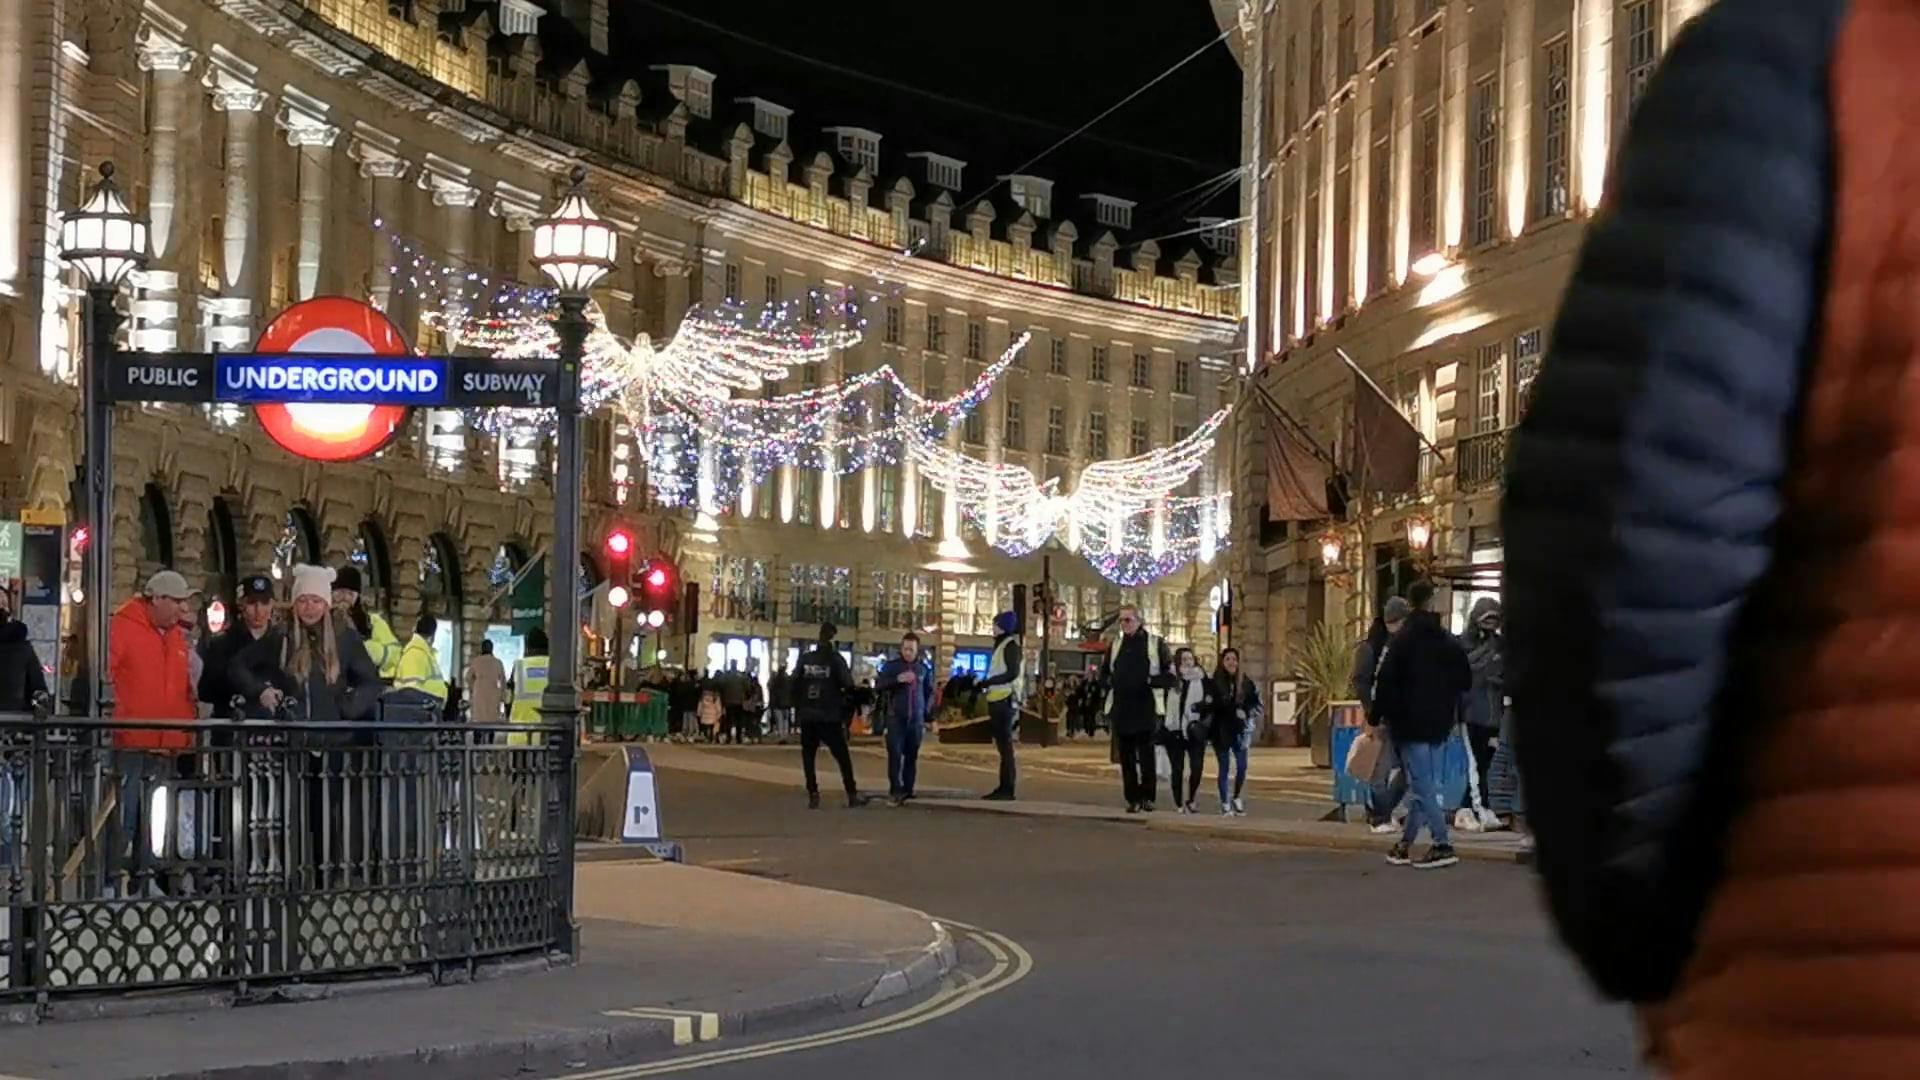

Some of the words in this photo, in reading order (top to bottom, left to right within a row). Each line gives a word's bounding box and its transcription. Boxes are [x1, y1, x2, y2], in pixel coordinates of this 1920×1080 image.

[127, 366, 199, 387] PUBLIC
[226, 366, 439, 393] UNDERGROUND
[463, 372, 546, 392] SUBWAY
